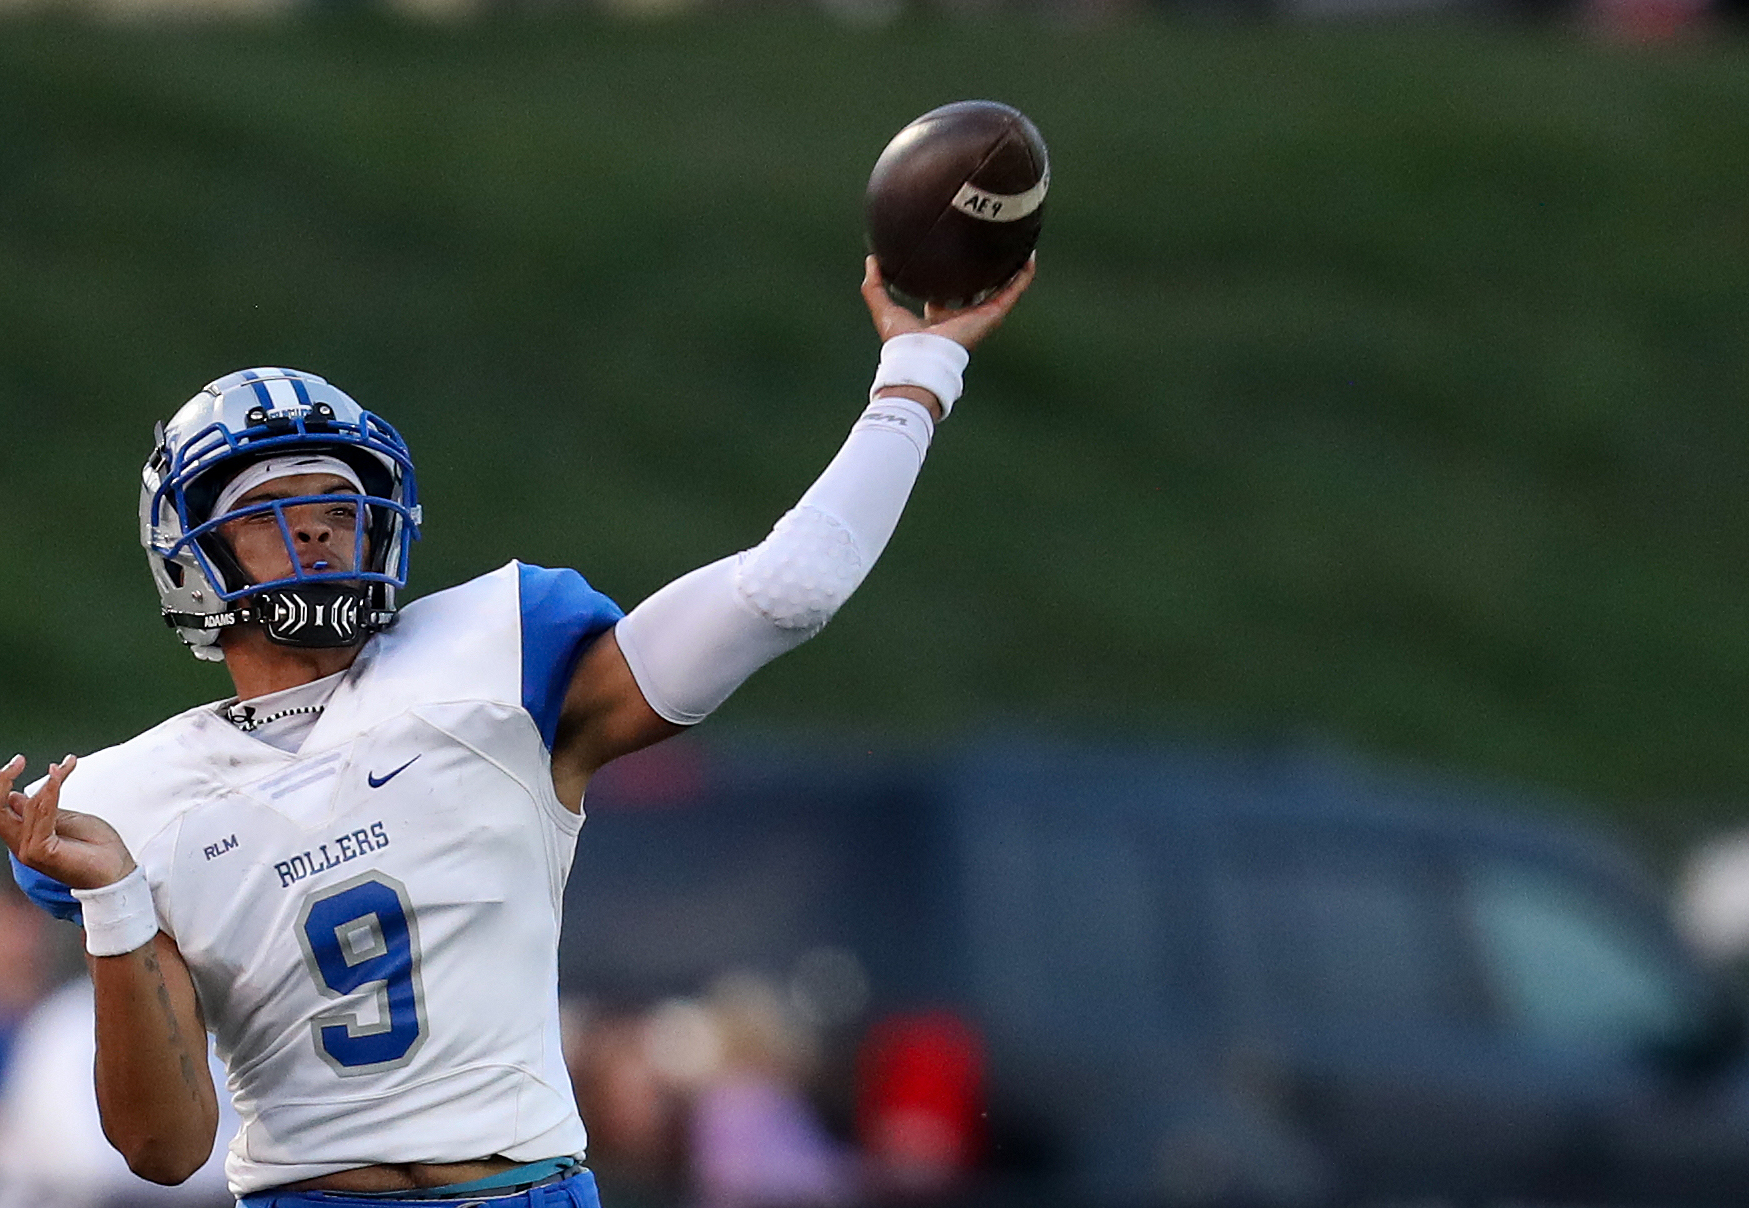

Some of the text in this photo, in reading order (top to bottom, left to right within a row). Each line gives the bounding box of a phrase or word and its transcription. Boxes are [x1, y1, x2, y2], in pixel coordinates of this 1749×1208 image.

[203, 612, 236, 628] ADAMS
[203, 833, 239, 861] RLM
[273, 821, 390, 888] ROLLERS
[294, 868, 430, 1079] 9
